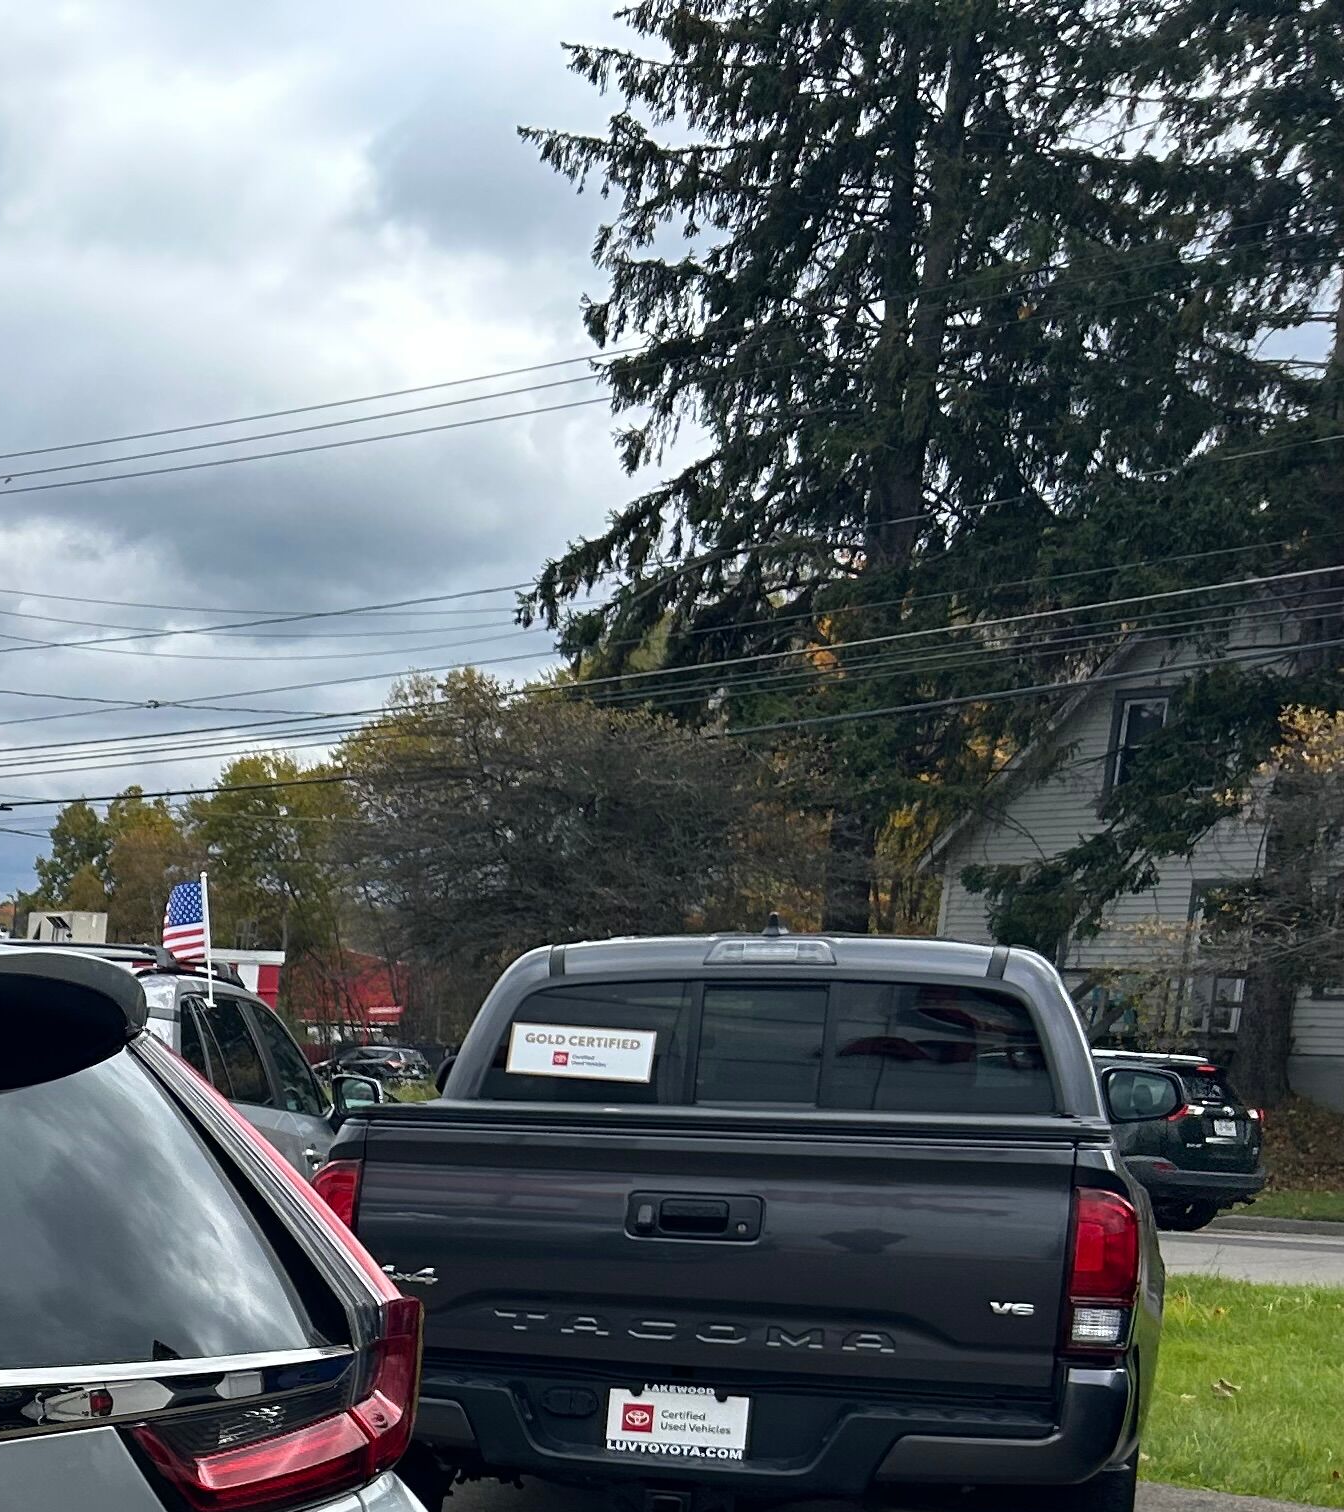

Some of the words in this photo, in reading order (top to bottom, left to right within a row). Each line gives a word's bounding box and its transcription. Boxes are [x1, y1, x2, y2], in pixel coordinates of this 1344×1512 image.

[525, 1032, 566, 1046] GOLD
[568, 1035, 641, 1050] CERTIFIED
[989, 1301, 1035, 1316] V6
[493, 1309, 897, 1354] TACOMA
[644, 1383, 715, 1395] LAKEWOOD
[661, 1409, 706, 1421] Certified
[660, 1422, 686, 1432] Used
[688, 1422, 731, 1435] Vehicles
[606, 1439, 743, 1460] LUVTOYOTA.COM
